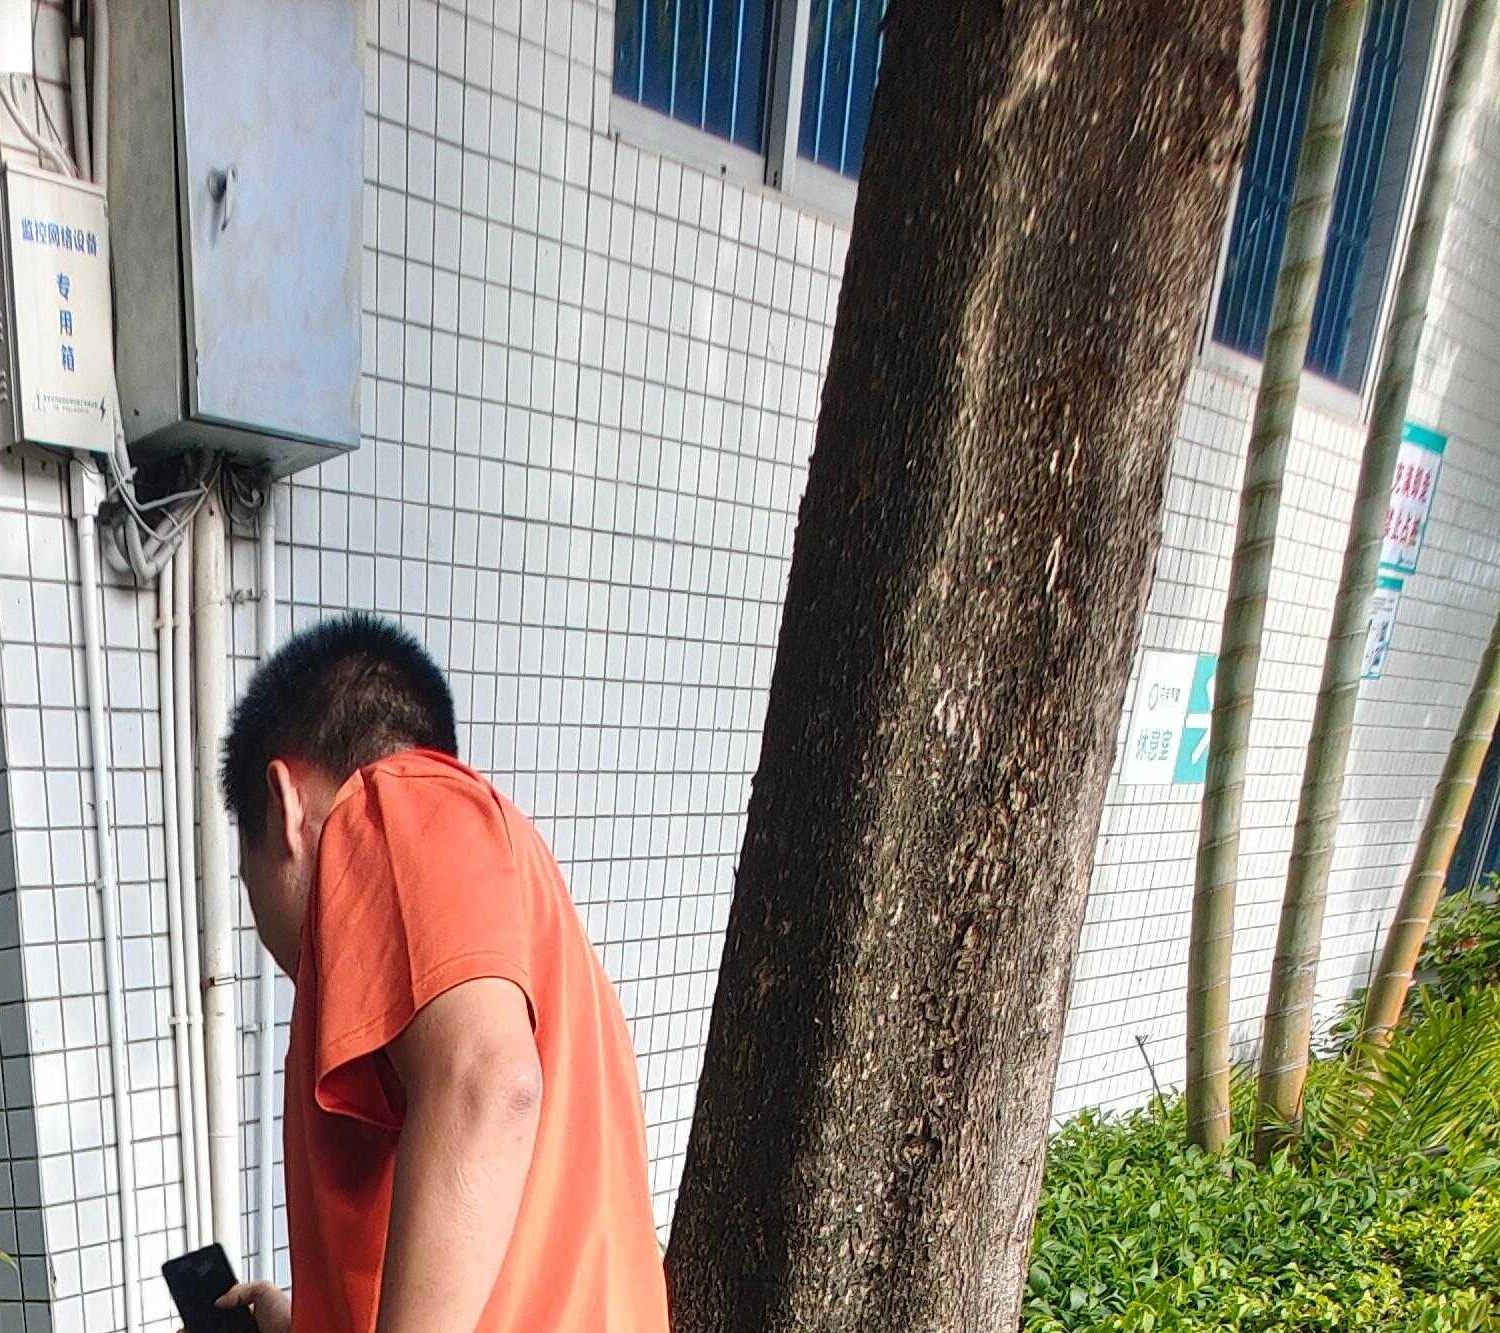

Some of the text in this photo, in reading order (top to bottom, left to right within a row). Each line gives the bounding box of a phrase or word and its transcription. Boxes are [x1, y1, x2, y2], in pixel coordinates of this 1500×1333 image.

[56, 272, 75, 372] 专用箱
[1135, 727, 1173, 761] 休息室
